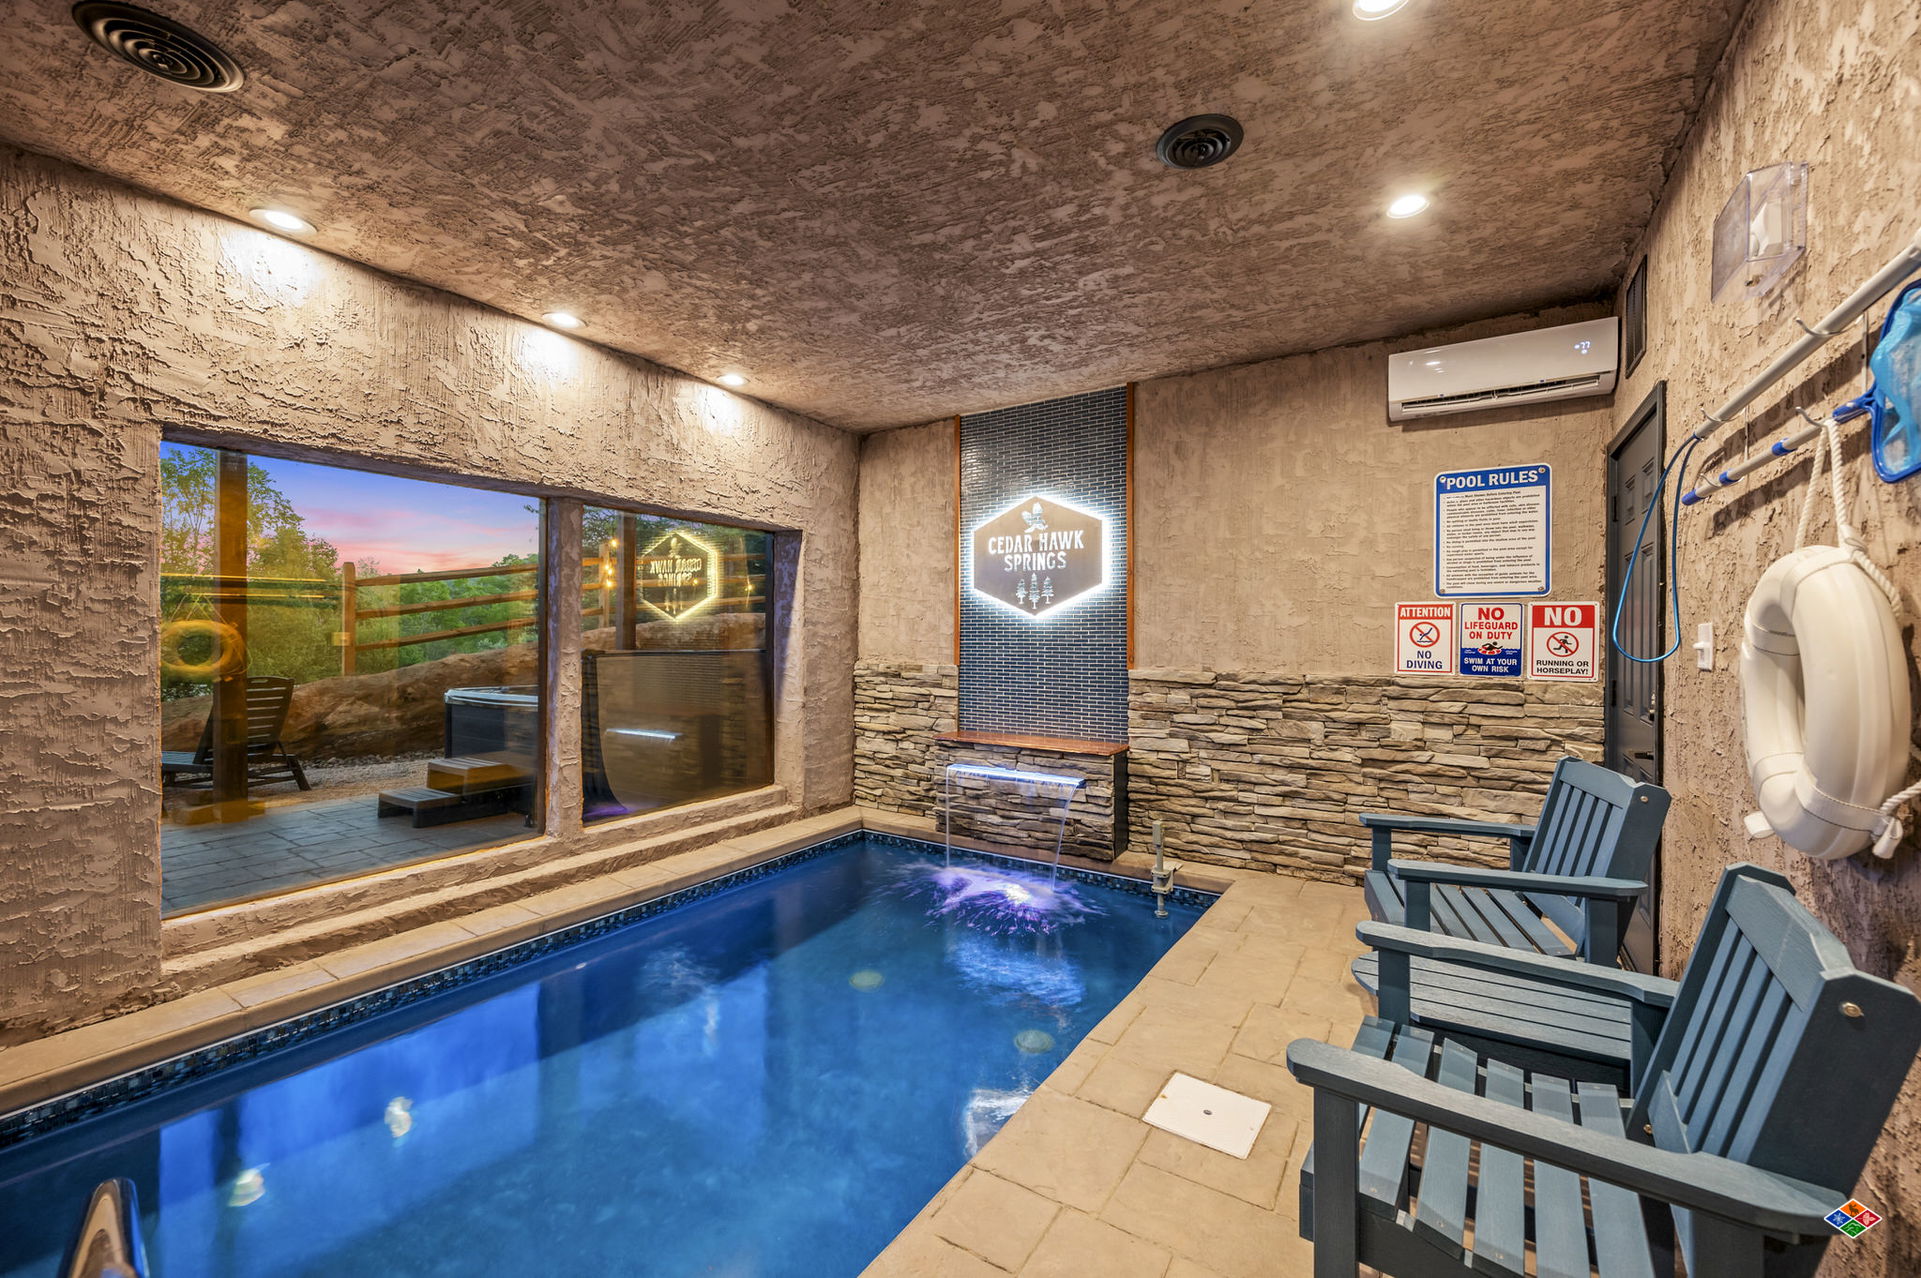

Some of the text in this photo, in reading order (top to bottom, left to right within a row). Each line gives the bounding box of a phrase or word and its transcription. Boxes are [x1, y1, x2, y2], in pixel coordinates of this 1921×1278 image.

[1447, 470, 1538, 490] POOL RULES
[988, 530, 1085, 554] CEDAR HAWK
[1004, 551, 1067, 572] SPRINGS
[1400, 606, 1451, 618] ATTENTION
[1477, 607, 1504, 621] NO
[1543, 607, 1582, 627] NO
[1464, 621, 1518, 630] LIFEGUARD
[1469, 631, 1512, 640] ON DUTY
[1417, 650, 1432, 659] NO
[1406, 659, 1443, 670] DIVING
[1463, 657, 1483, 665] SWIM
[1496, 658, 1517, 666] YOUR
[1536, 659, 1574, 667] RUNNING
[1491, 665, 1509, 673] RISK
[1536, 667, 1589, 675] HORSEPLAY!
